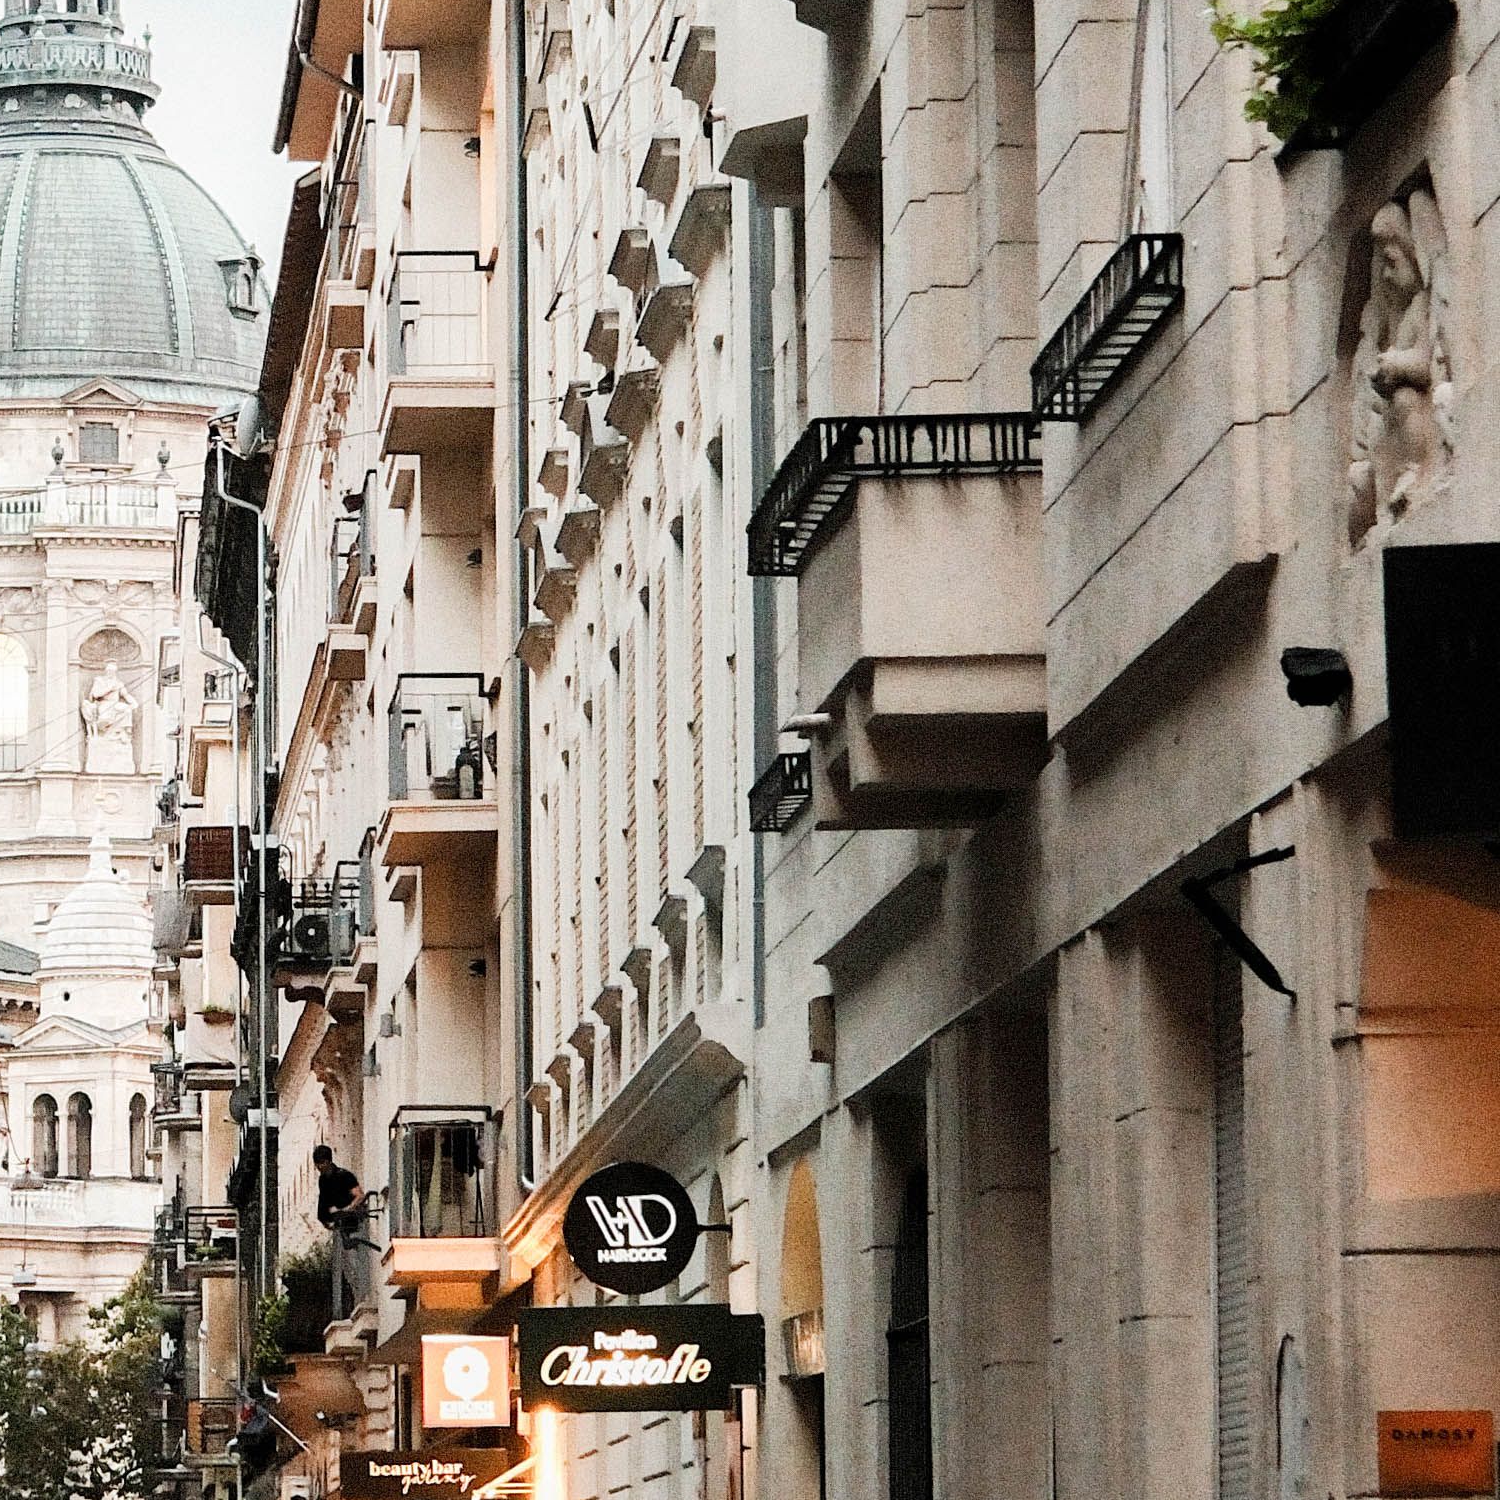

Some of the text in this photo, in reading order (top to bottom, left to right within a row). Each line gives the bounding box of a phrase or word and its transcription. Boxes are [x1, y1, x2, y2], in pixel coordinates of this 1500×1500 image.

[540, 1343, 712, 1386] Christofle
[368, 1459, 463, 1479] beauty bar
[401, 1470, 477, 1495] galaxy
